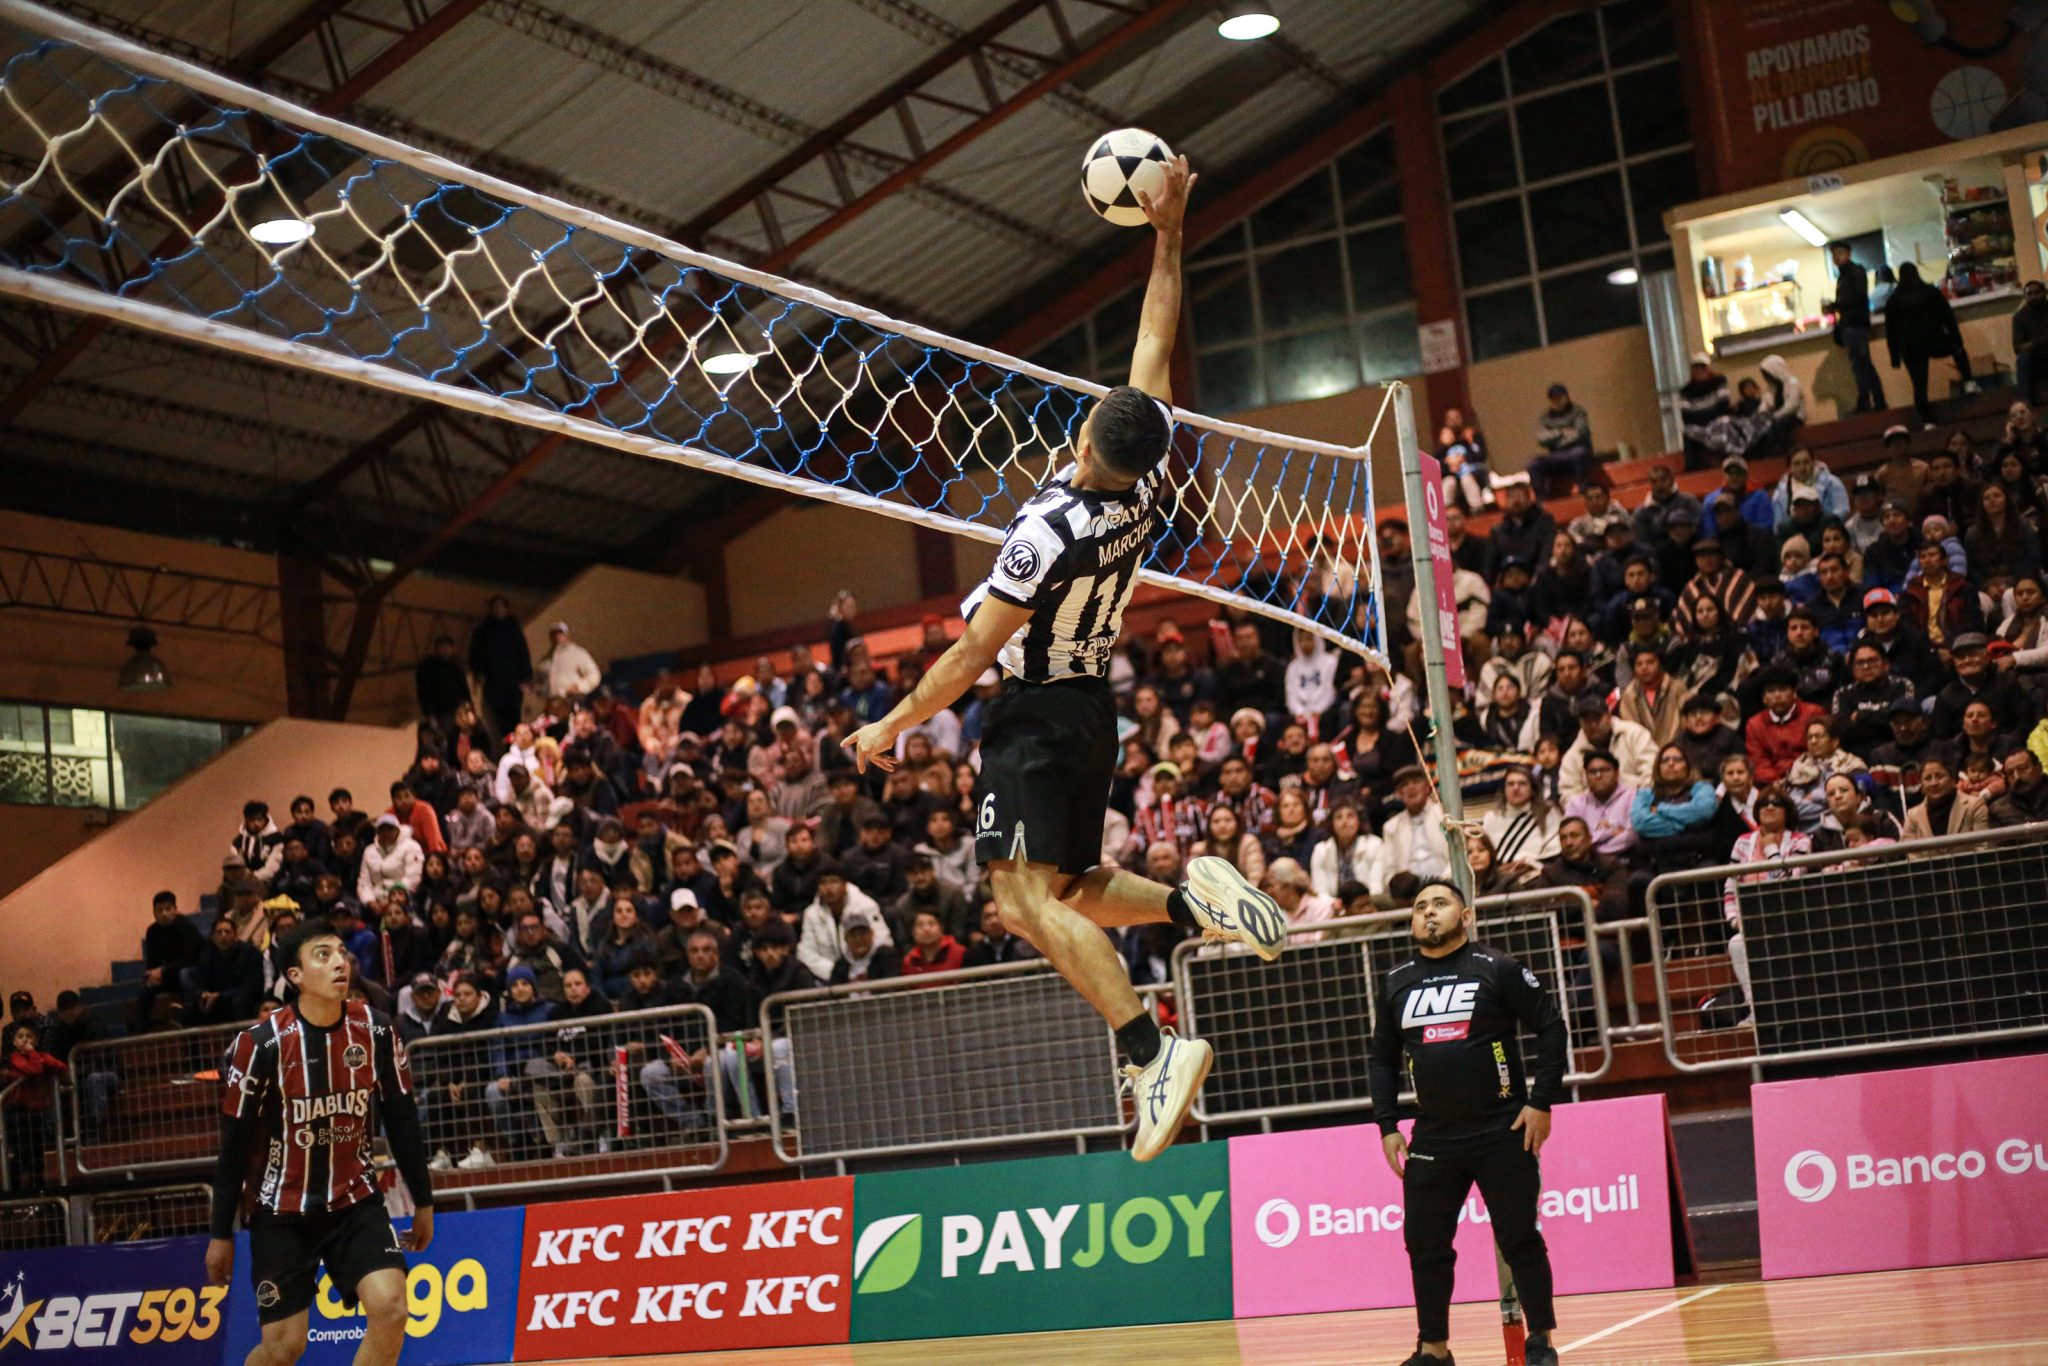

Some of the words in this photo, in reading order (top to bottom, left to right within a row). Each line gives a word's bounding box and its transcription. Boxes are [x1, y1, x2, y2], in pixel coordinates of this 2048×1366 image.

[1747, 25, 1871, 79] APOYAMOS
[1753, 75, 1880, 133] PILLAREÑO
[976, 793, 995, 833] 6
[291, 1088, 368, 1124] DIABLOS
[1847, 1151, 1986, 1189] Banco
[941, 1190, 1224, 1278] PAYJOY
[1308, 1203, 1405, 1237] Banc
[1457, 1174, 1640, 1231] uaquil
[532, 1224, 624, 1267] KFC
[635, 1215, 731, 1259] KFC
[743, 1207, 843, 1251] KFC
[527, 1289, 620, 1331] KFC
[630, 1282, 727, 1324] KFC
[739, 1274, 839, 1317] KFC
